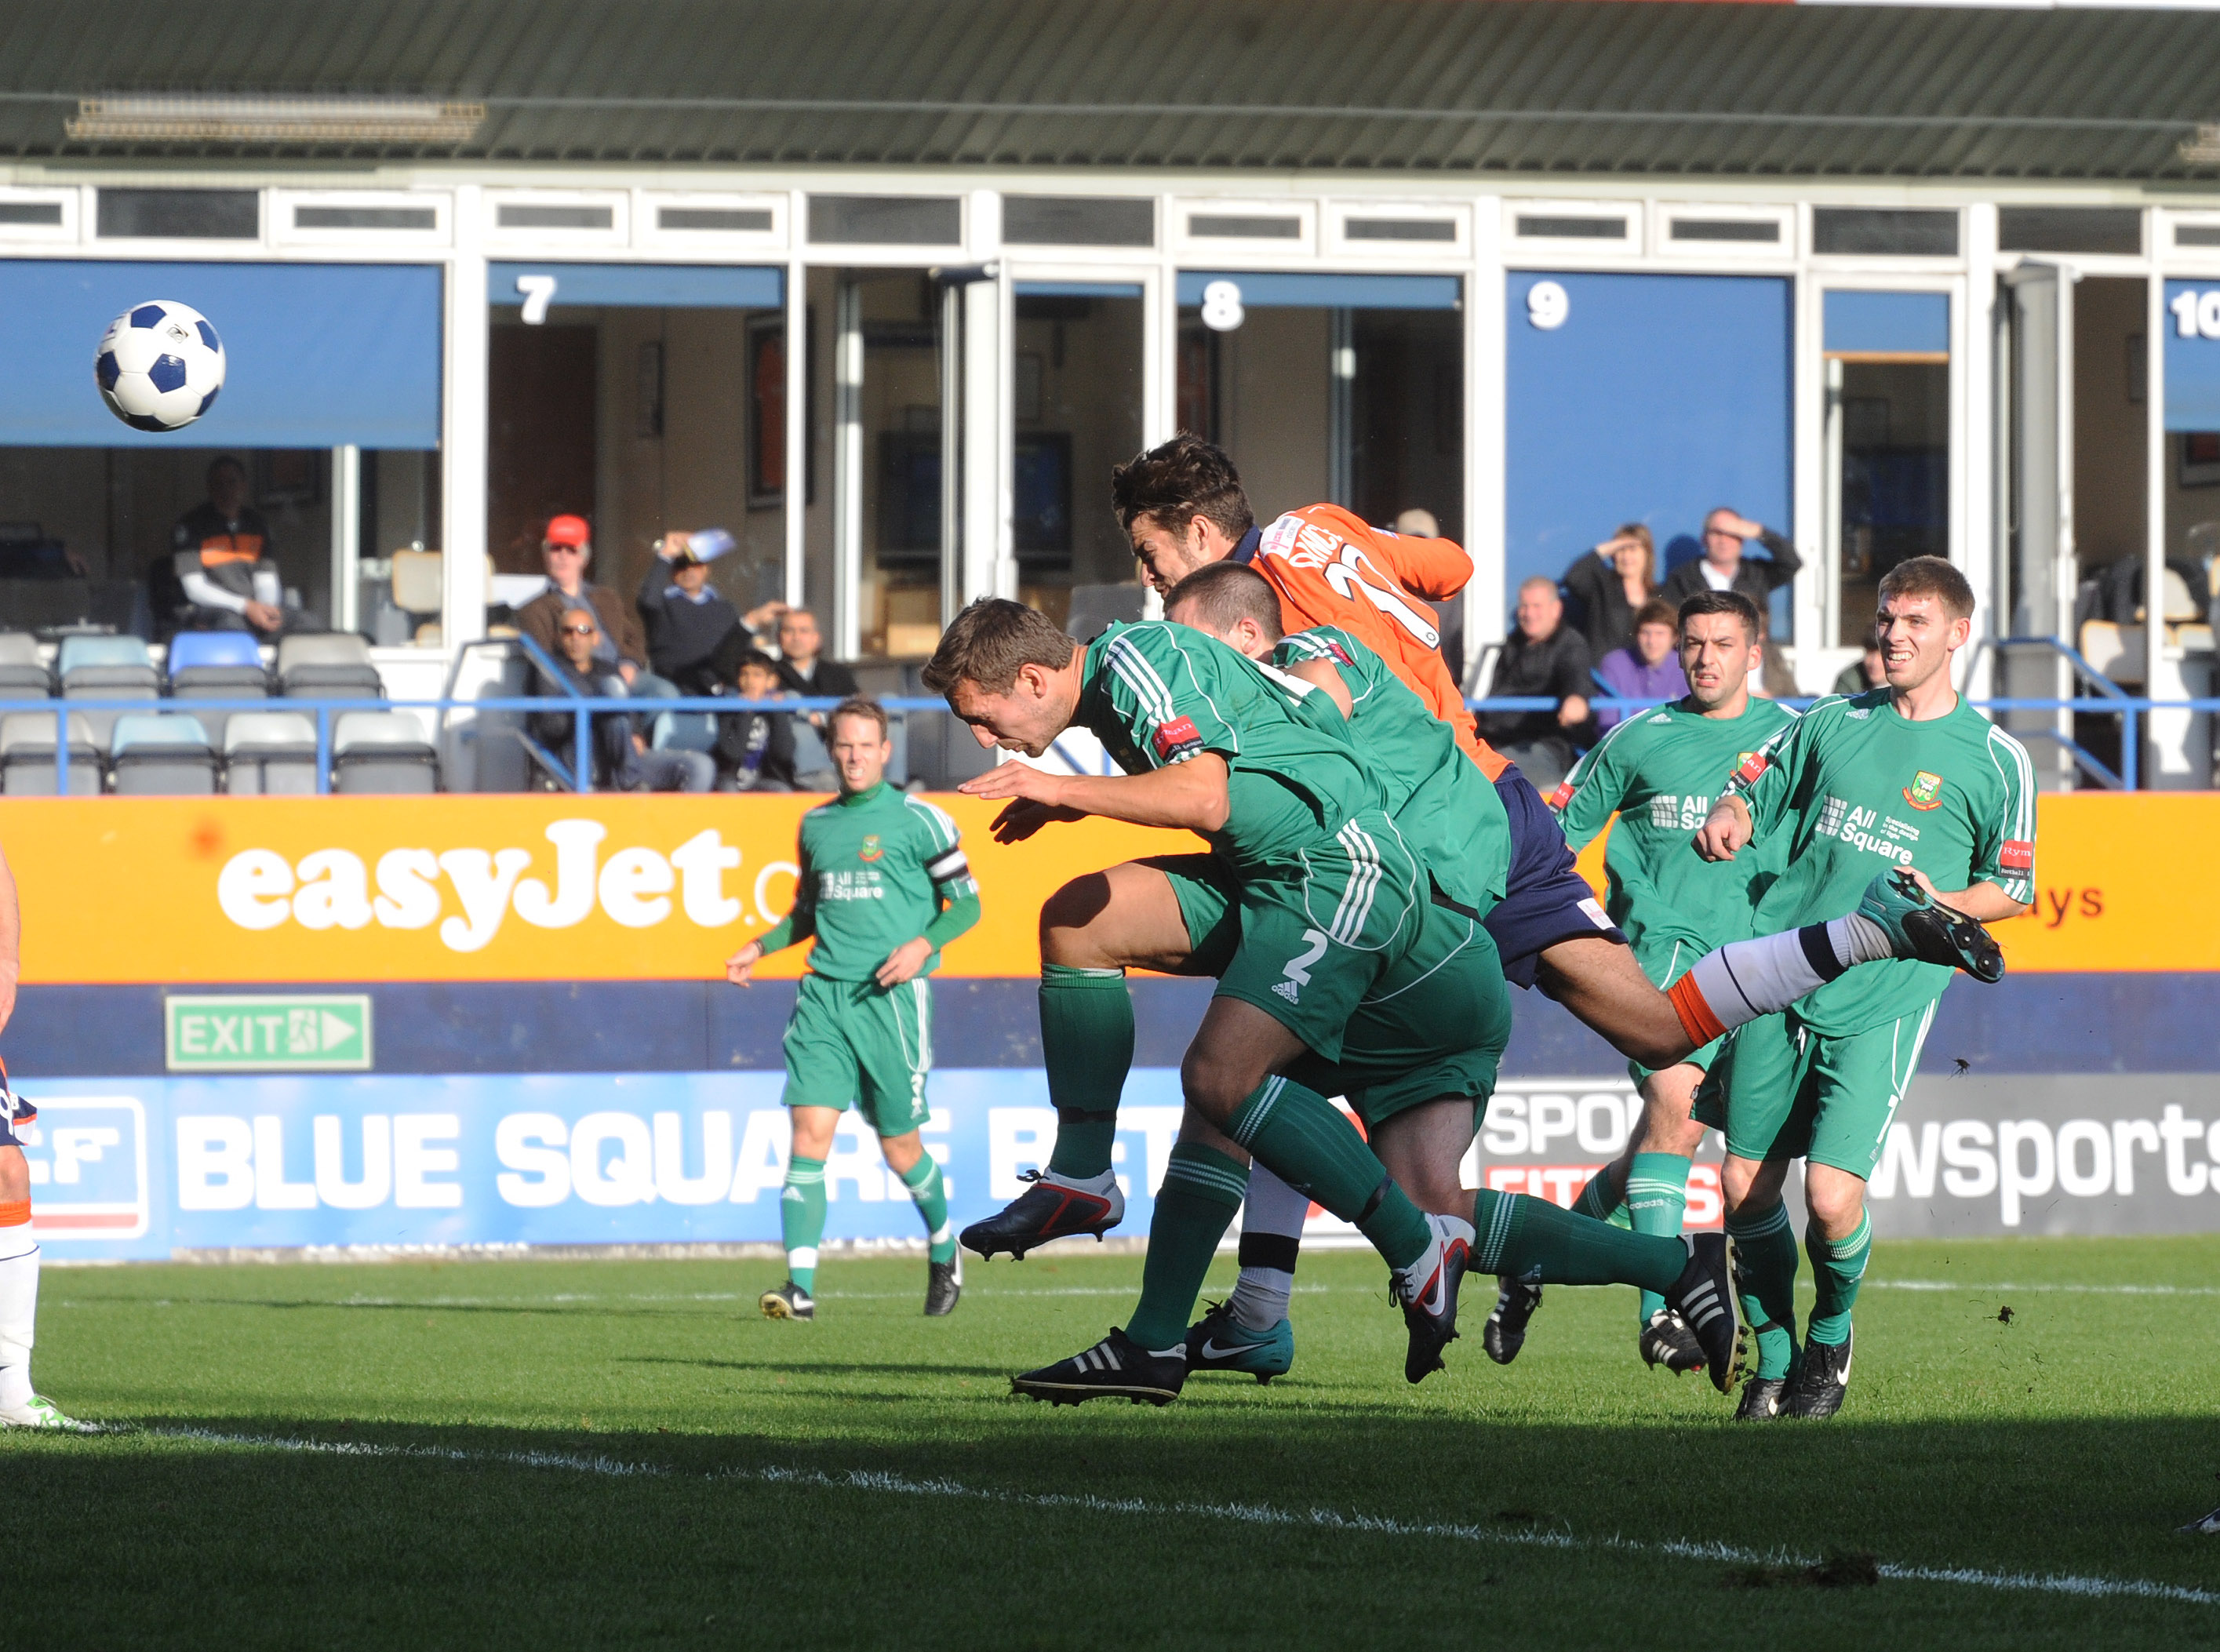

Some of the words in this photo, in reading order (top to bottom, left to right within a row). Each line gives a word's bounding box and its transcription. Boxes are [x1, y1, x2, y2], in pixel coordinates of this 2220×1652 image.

[516, 274, 555, 326] 7
[1201, 280, 1245, 332] 8
[1527, 280, 1568, 330] 9
[2170, 289, 2220, 339] 10
[1681, 795, 1708, 813] All
[1847, 805, 1877, 828] All
[1840, 822, 1913, 865] Square
[834, 886, 883, 901] Square
[838, 871, 851, 885] All
[1282, 928, 1328, 987] 2
[180, 1015, 282, 1053] EXIT
[177, 1113, 462, 1210] BLUE
[495, 1108, 954, 1209] SQUARE
[989, 1107, 1185, 1200] BT
